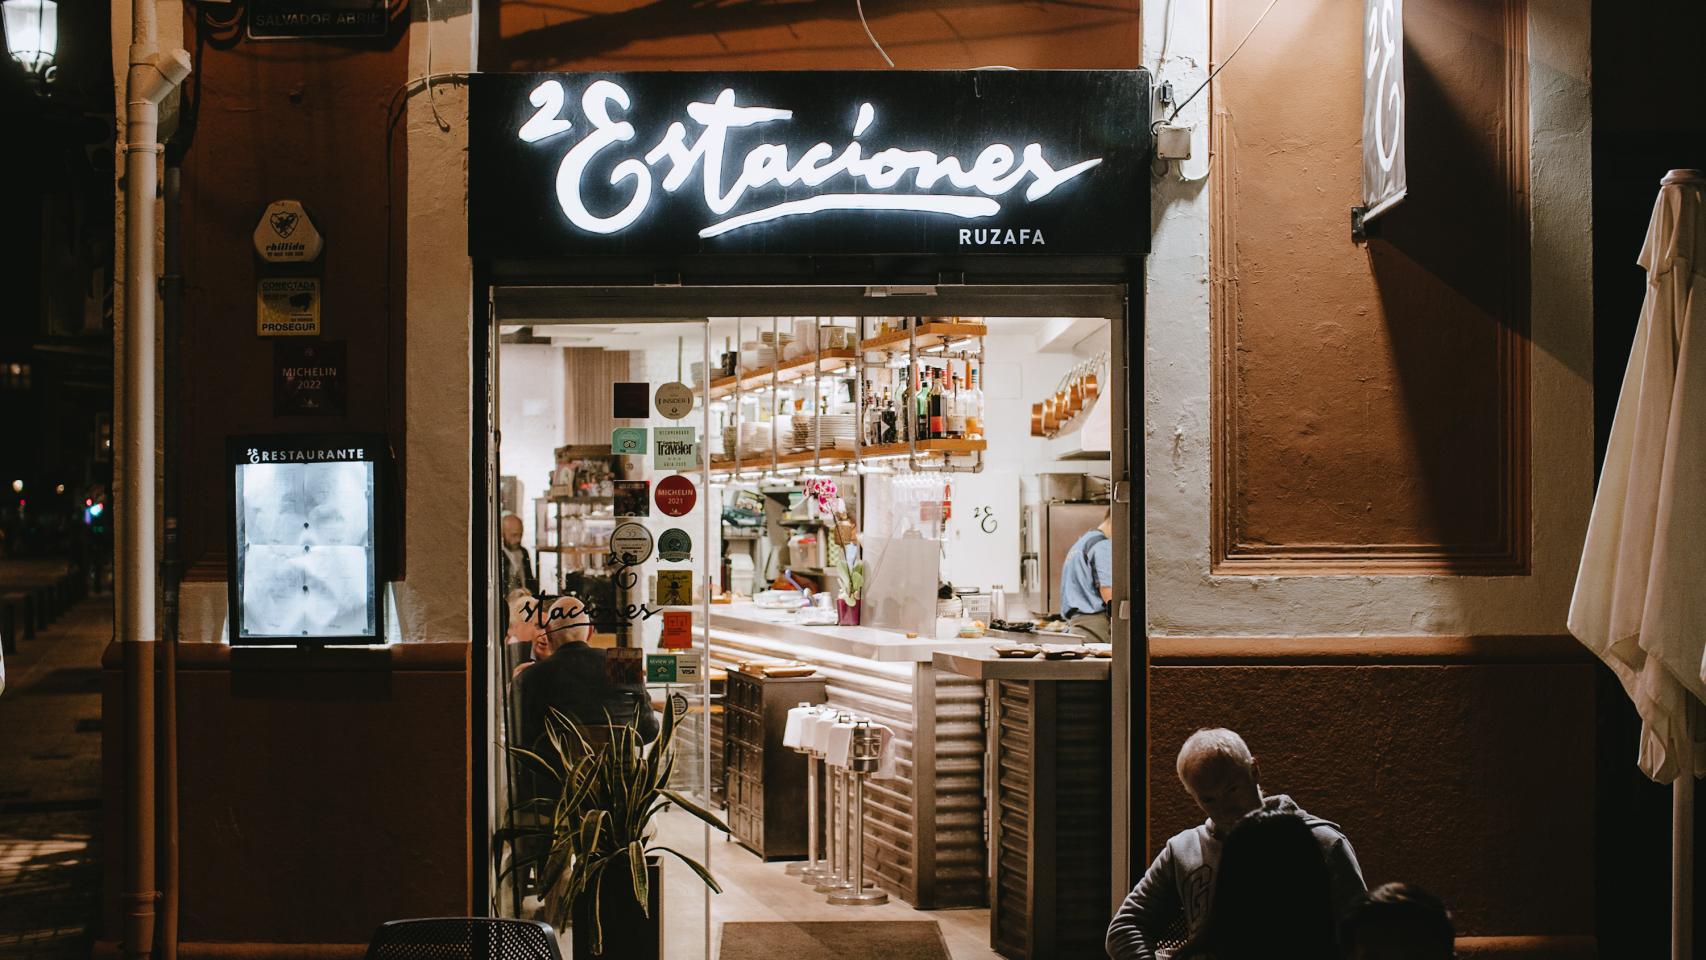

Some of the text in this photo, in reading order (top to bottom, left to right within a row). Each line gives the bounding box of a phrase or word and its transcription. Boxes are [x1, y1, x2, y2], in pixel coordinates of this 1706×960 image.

[255, 13, 331, 26] SALVADOR
[958, 228, 1046, 245] RUZAFA
[262, 281, 316, 289] CONECTADA
[262, 323, 316, 331] PROSEGUR
[282, 367, 337, 377] MICHELIN
[297, 379, 321, 390] 2022
[261, 447, 365, 461] RESTAURANTE
[656, 440, 693, 456] Traveler
